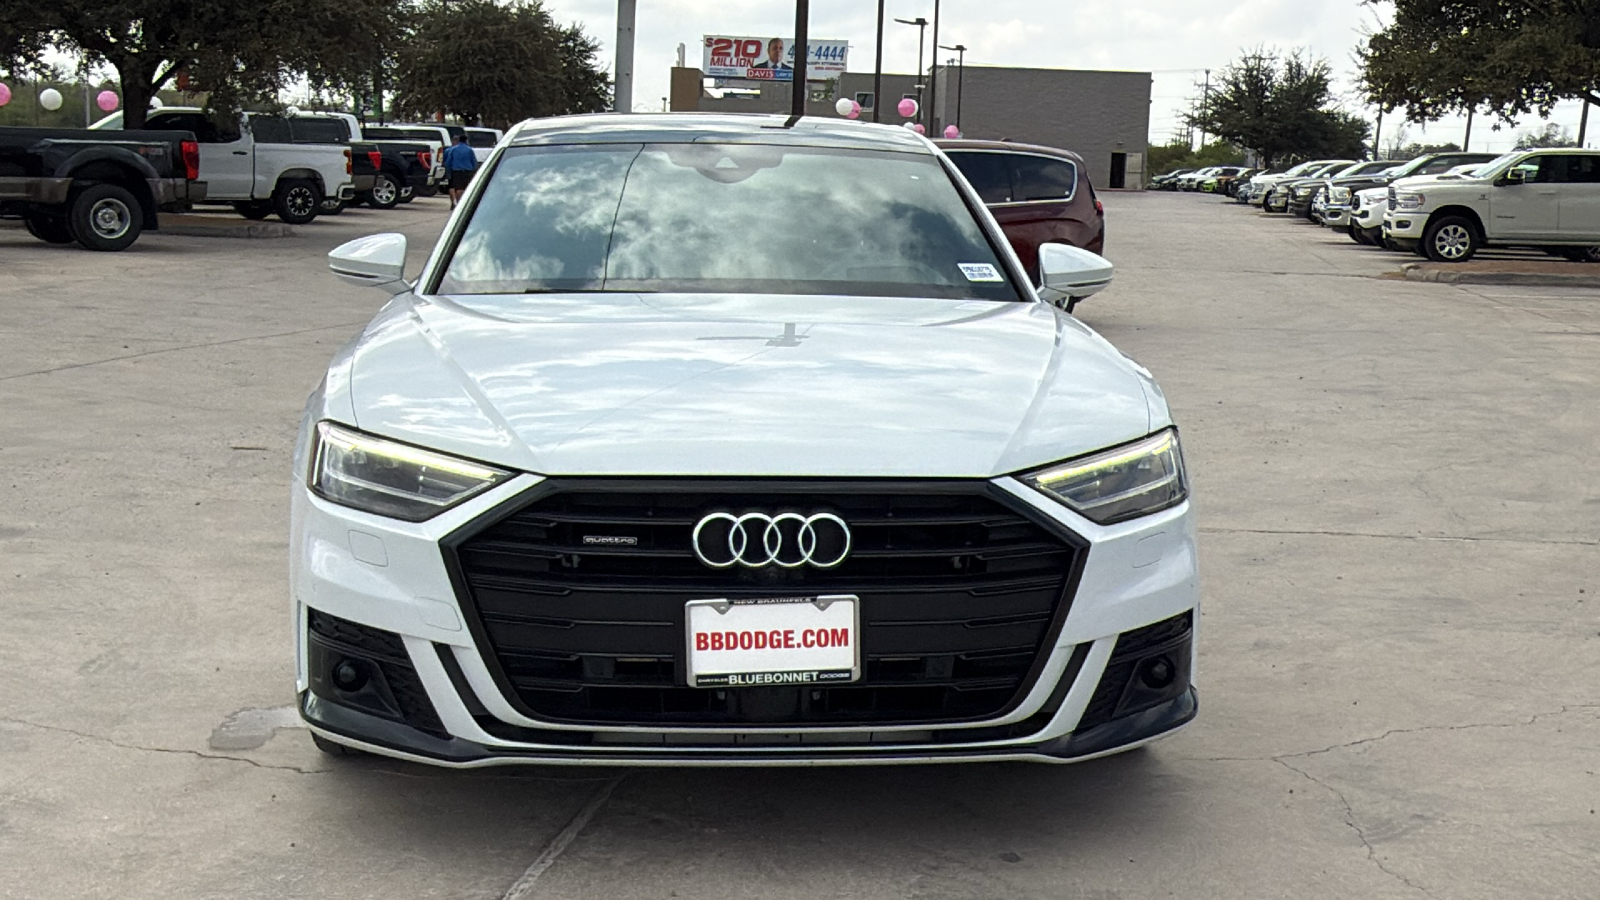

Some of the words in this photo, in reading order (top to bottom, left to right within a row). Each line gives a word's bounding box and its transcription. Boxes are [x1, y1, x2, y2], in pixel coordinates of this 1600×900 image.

[705, 37, 762, 58] $210
[787, 45, 845, 61] 4-4444
[710, 56, 754, 68] MILLION
[748, 70, 774, 78] DAVIS
[696, 628, 849, 651] BBDODGE.COM
[728, 671, 819, 685] BLUEBONNET
